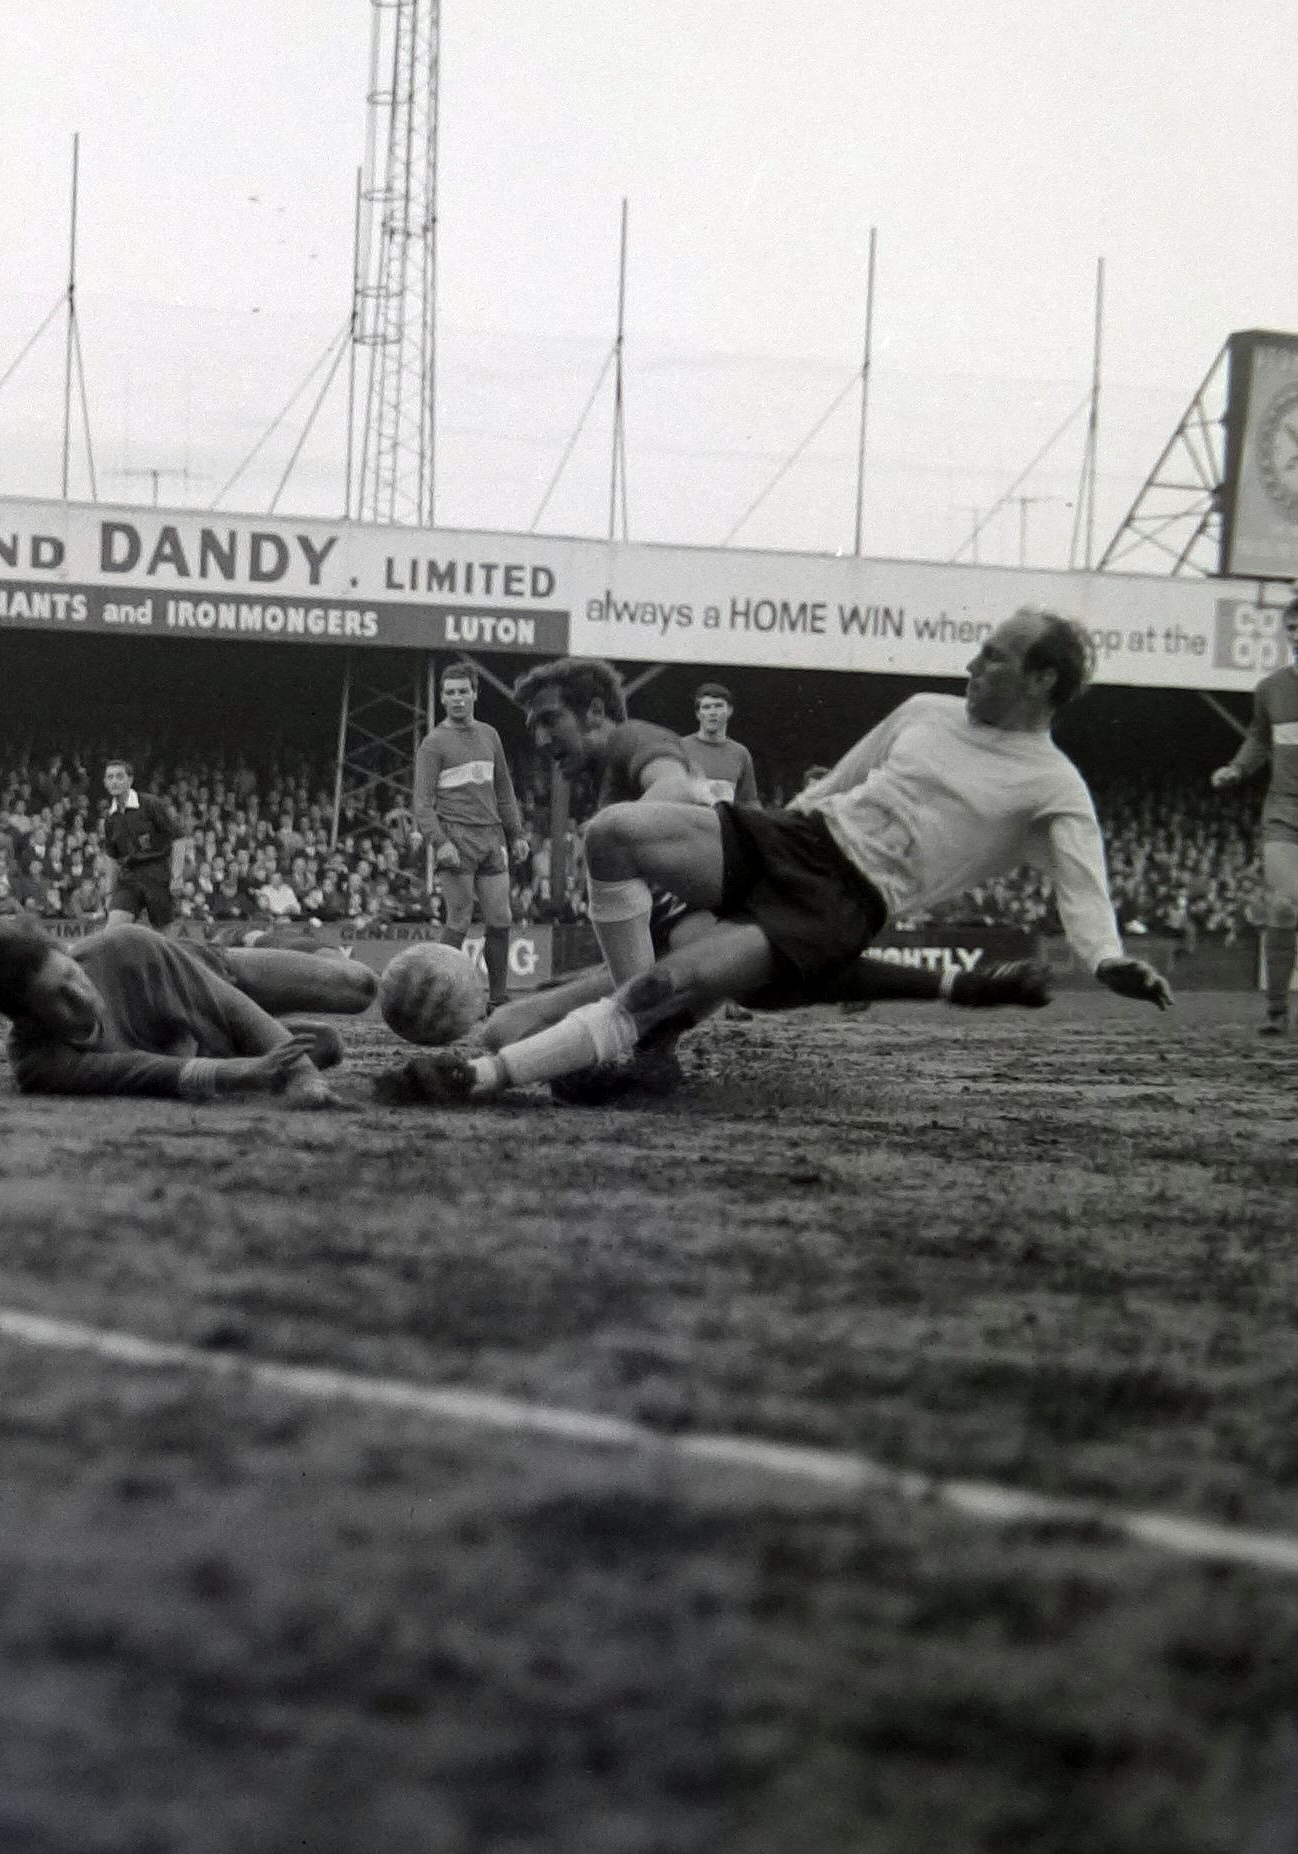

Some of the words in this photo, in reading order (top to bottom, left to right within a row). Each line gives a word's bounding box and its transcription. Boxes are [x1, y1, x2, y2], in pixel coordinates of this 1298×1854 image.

[384, 555, 557, 600] LIMITED
[102, 600, 153, 626] and
[166, 600, 380, 638] IRONMONGERS
[445, 613, 536, 645] LUTON
[585, 588, 694, 637] always
[702, 605, 722, 630] a
[729, 597, 828, 634] HOME
[838, 602, 906, 639] WIN
[1127, 624, 1157, 654] at
[1162, 623, 1208, 656] the
